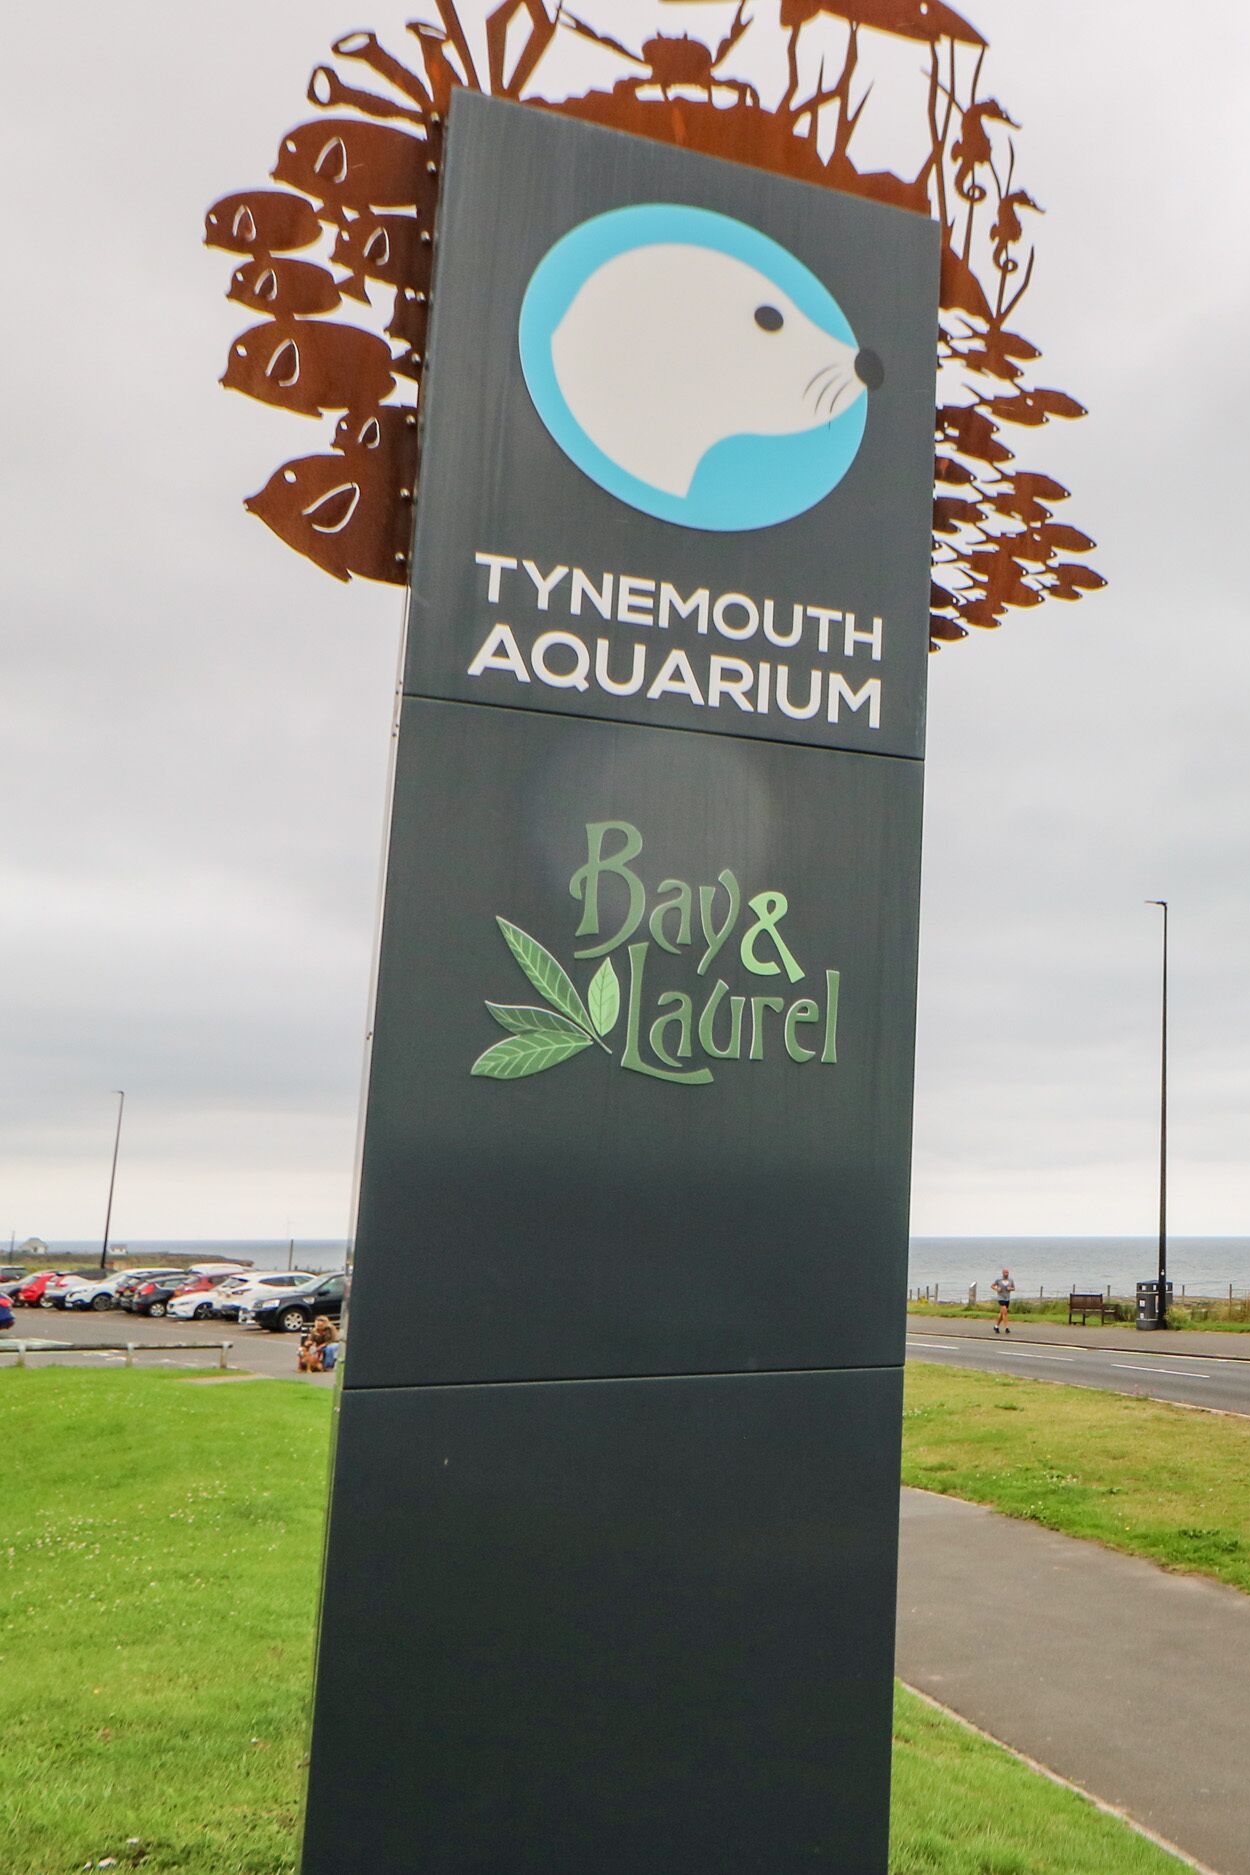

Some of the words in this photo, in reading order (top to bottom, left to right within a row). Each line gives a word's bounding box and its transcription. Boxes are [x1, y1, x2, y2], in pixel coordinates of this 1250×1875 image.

[475, 552, 882, 661] TYNEMOUTH
[467, 623, 882, 729] AQUARIUM
[569, 820, 740, 976] Bay
[740, 891, 806, 984] &
[621, 942, 841, 1084] Laurel
